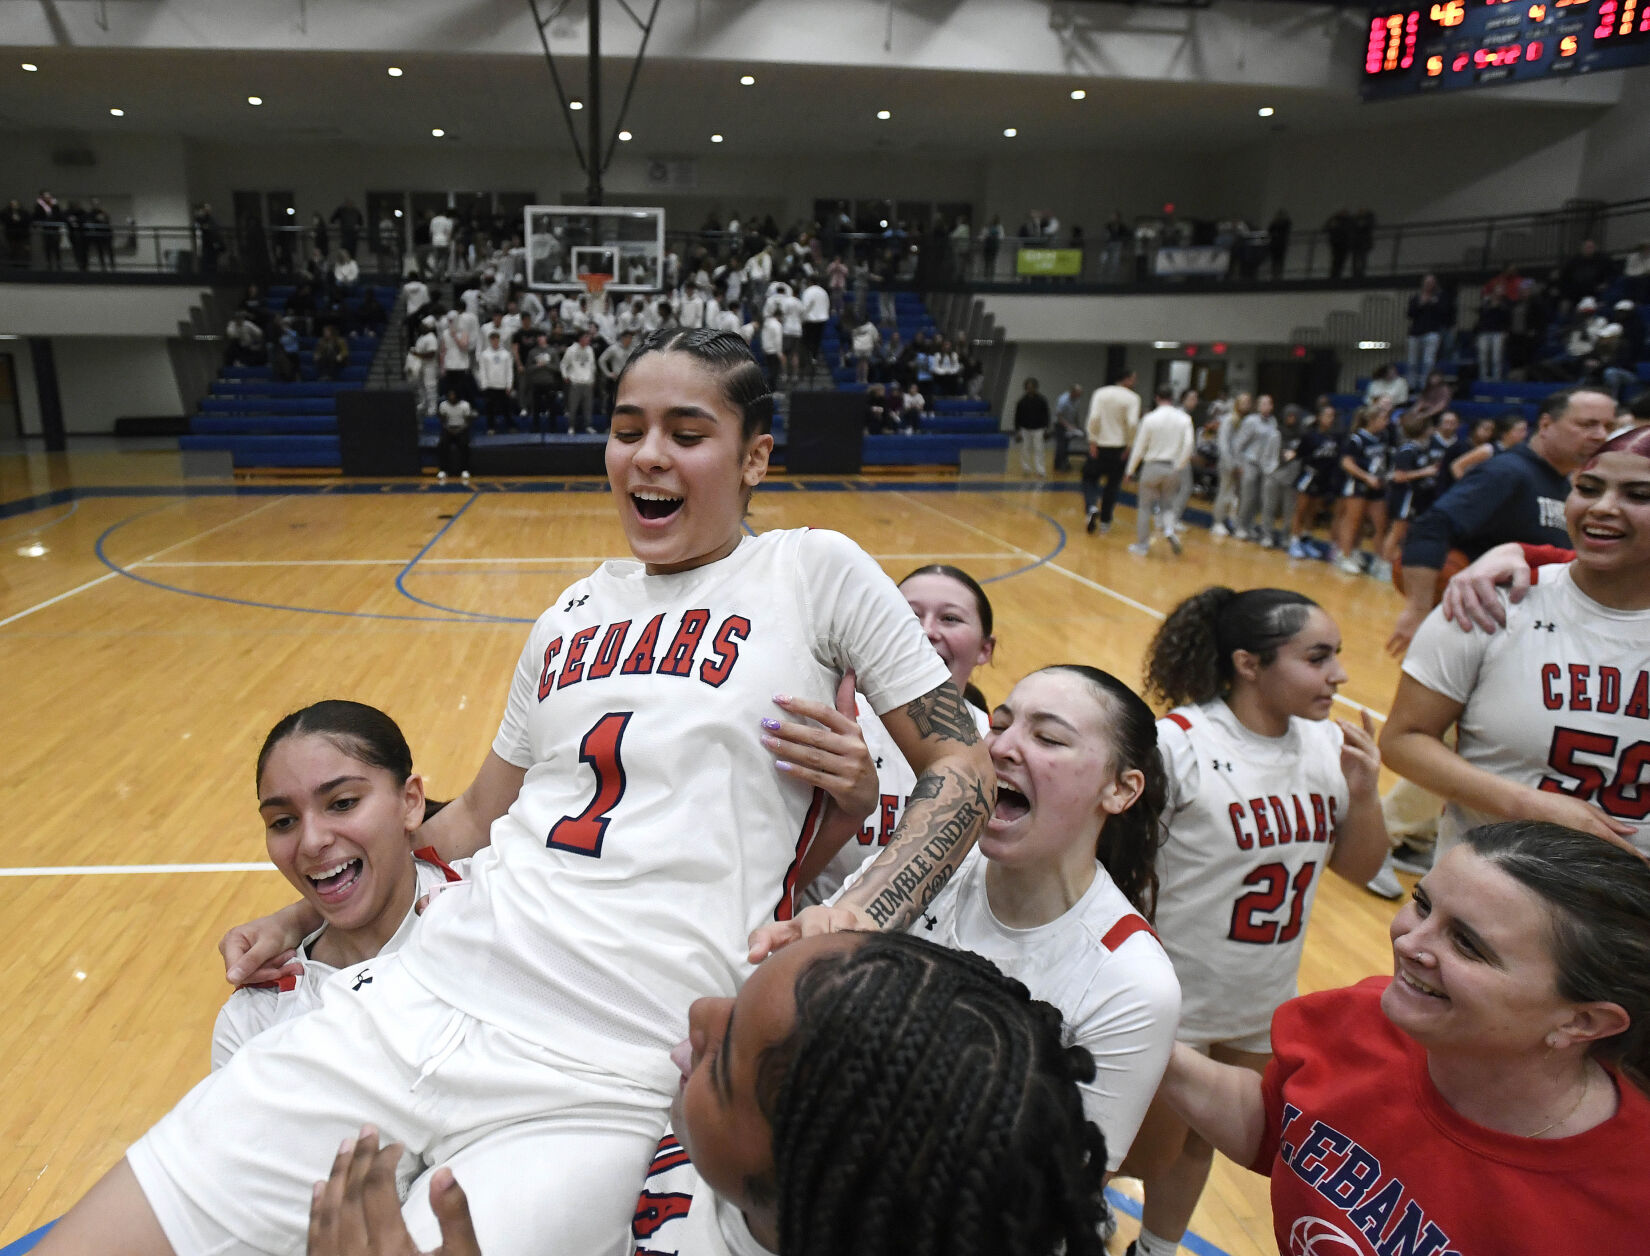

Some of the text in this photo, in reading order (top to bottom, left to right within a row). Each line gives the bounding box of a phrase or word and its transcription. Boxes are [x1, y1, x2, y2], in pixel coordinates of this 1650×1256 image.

[537, 608, 751, 704] CEDARS
[546, 711, 634, 859] 1
[1229, 793, 1337, 850] CEDARS
[865, 801, 982, 929] HUMBLE UNDER
[1227, 861, 1316, 944] 21
[1280, 1102, 1463, 1256] LEBAN
